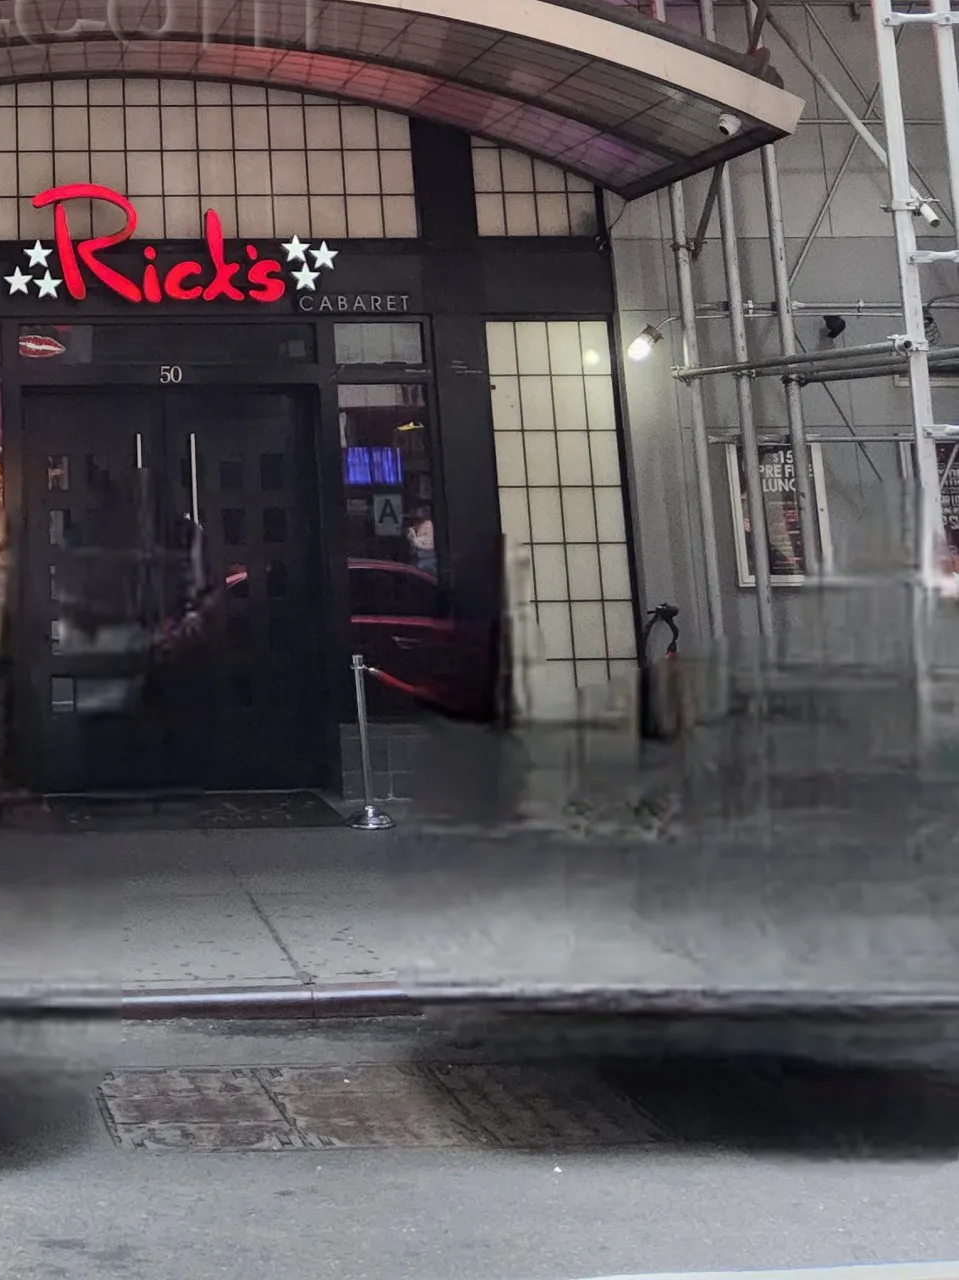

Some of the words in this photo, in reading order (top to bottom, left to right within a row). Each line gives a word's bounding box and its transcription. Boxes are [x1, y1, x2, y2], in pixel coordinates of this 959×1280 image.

[32, 183, 286, 302] Rick's
[299, 295, 409, 311] CABARET
[159, 365, 183, 383] 50
[378, 498, 399, 523] A
